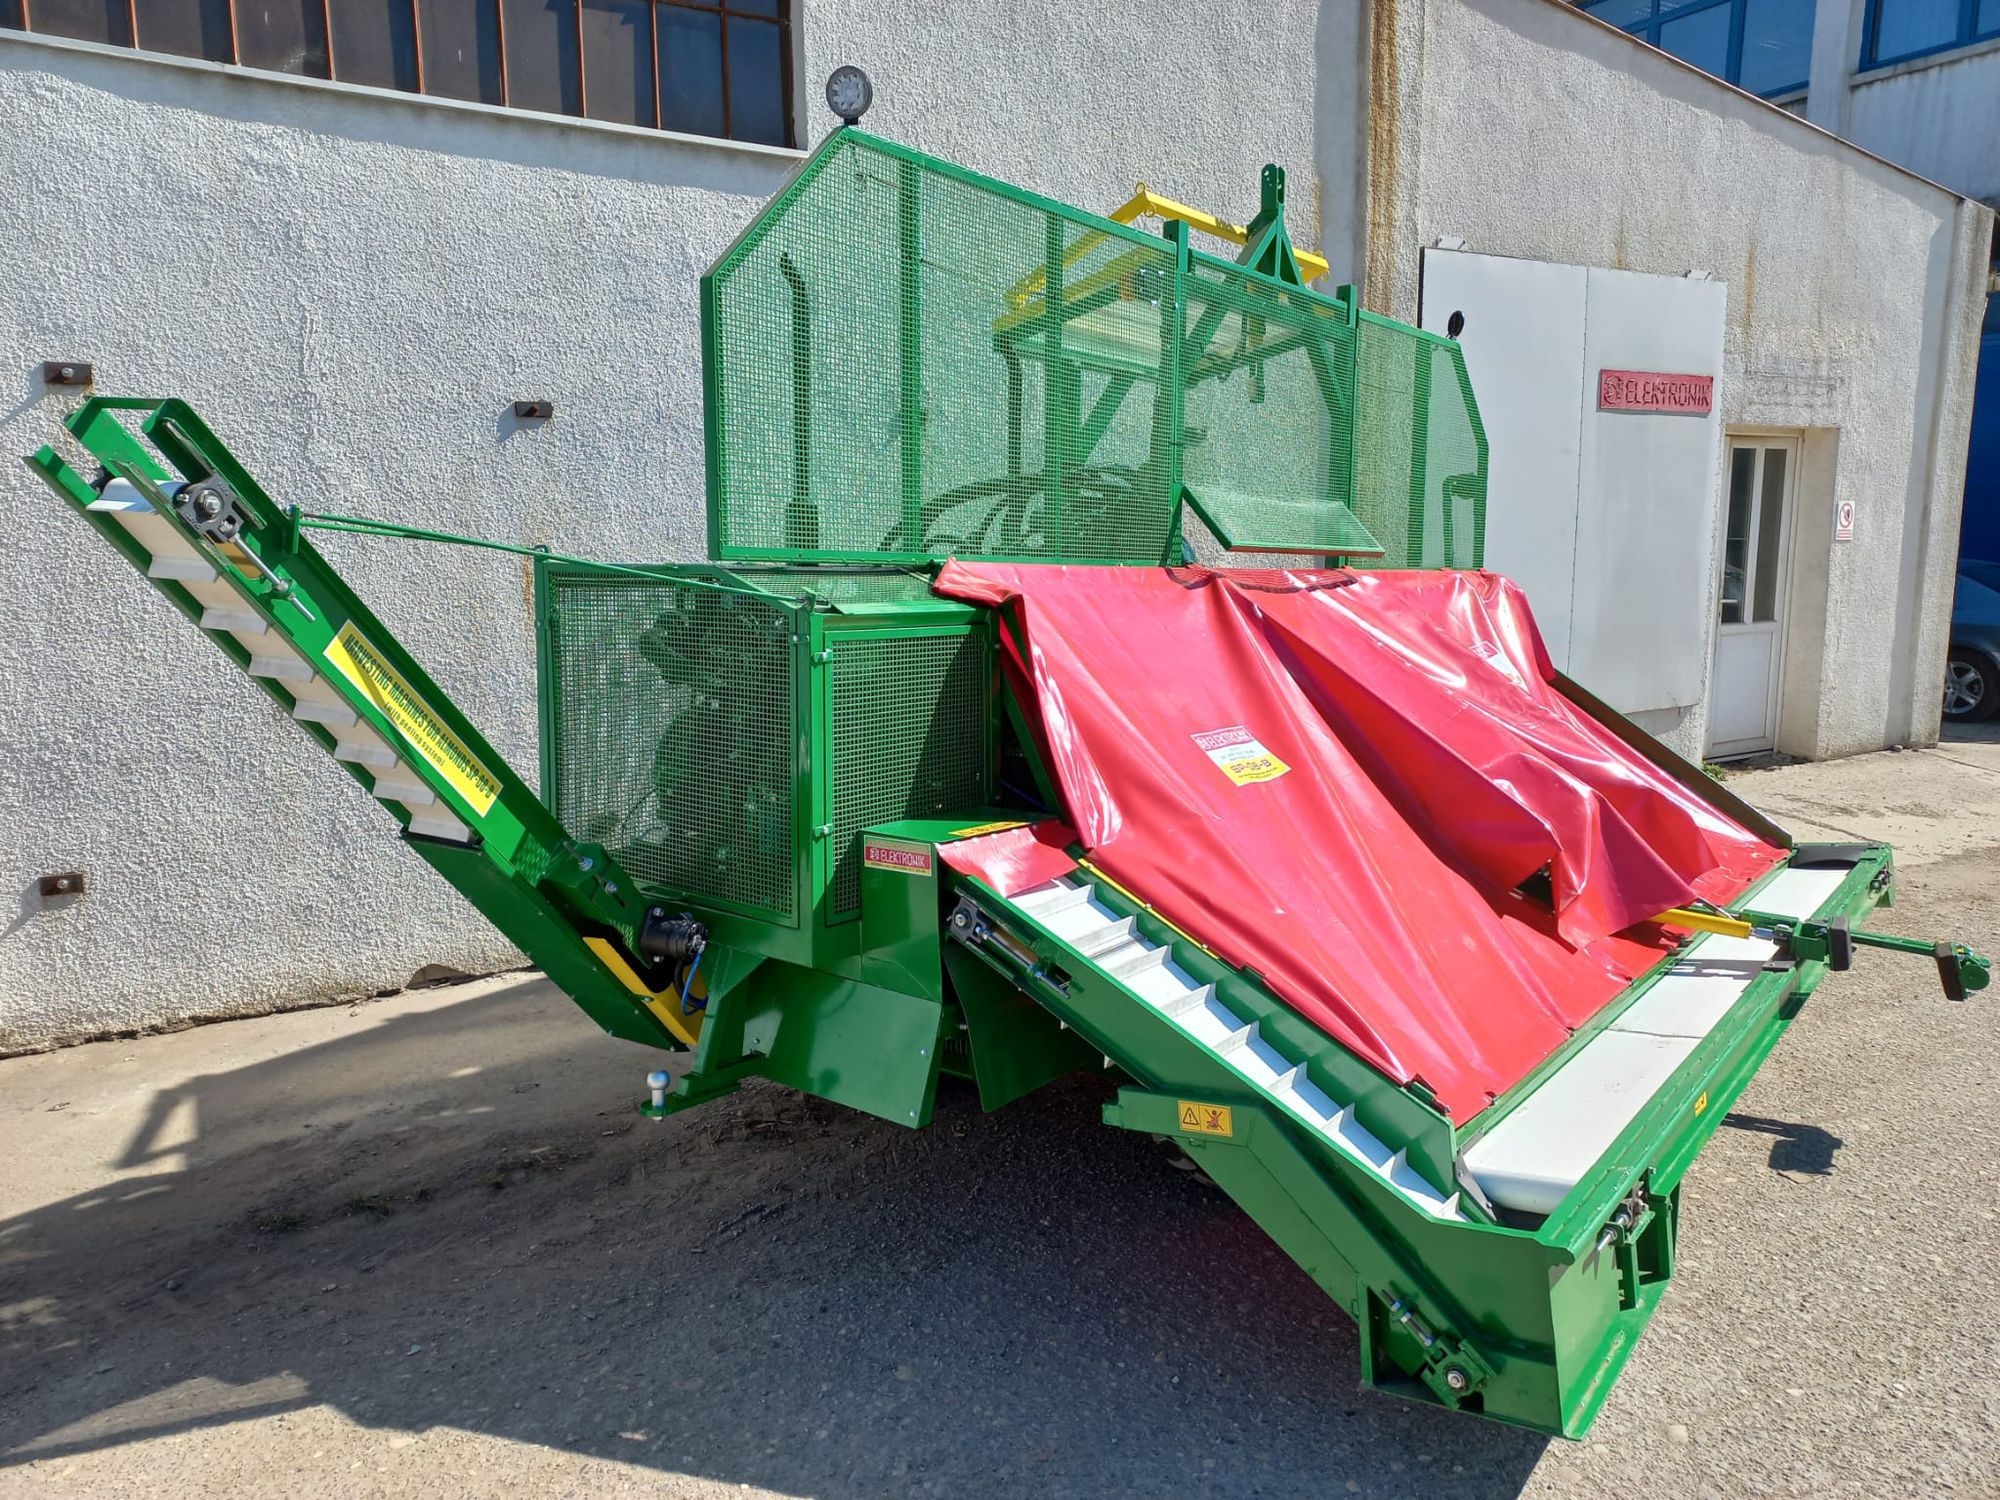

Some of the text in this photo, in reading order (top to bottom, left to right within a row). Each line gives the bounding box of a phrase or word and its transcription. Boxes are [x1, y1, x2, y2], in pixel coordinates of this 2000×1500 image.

[1625, 378, 1710, 407] ELEKTRONIK
[342, 633, 393, 690] HARVESTING
[388, 681, 428, 727] MACHINES
[422, 717, 441, 742] FOR
[435, 732, 471, 773] ALMONDS
[384, 701, 444, 767] (with peeling system)
[880, 849, 925, 868] ELEKTRONIK
